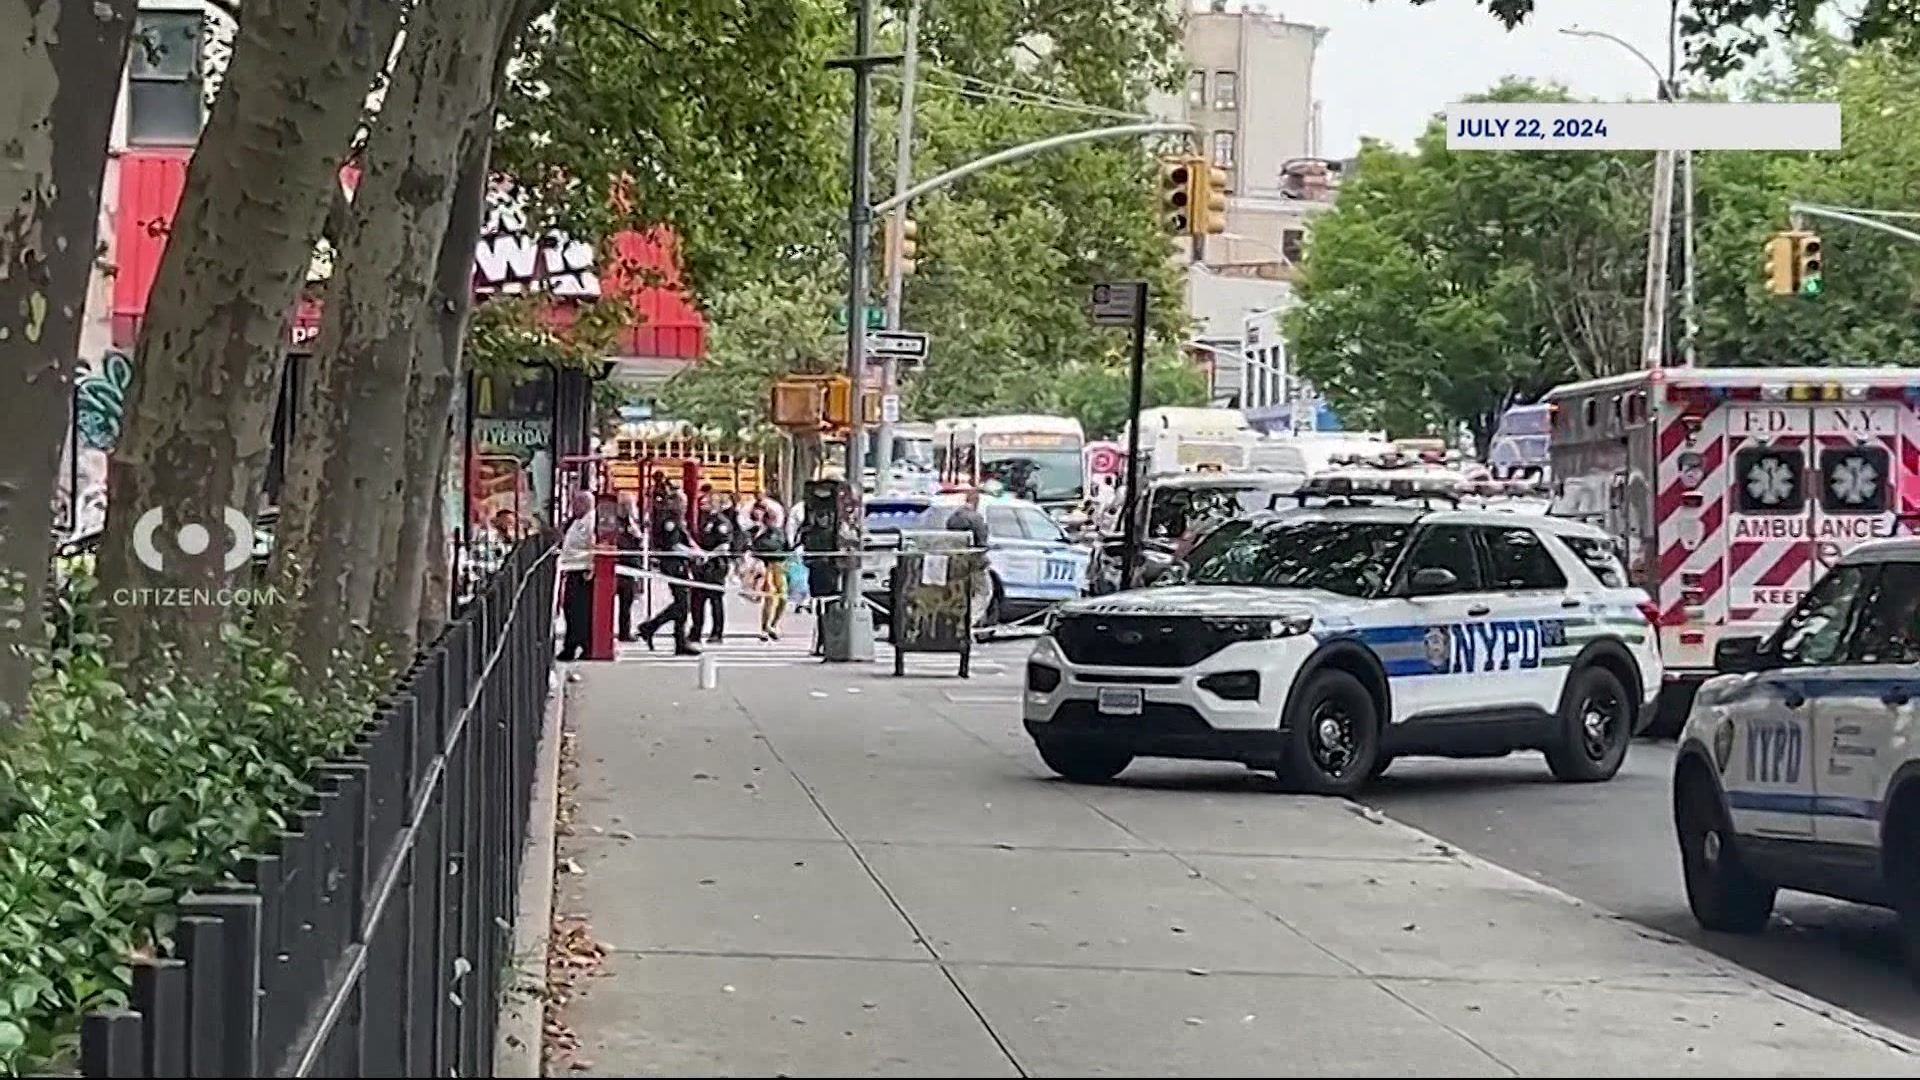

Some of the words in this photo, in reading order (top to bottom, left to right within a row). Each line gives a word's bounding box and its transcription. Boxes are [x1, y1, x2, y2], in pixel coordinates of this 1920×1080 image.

[1736, 518, 1884, 538] AMBULANCE
[1451, 621, 1539, 673] NYPD
[1746, 719, 1801, 783] NYPD
